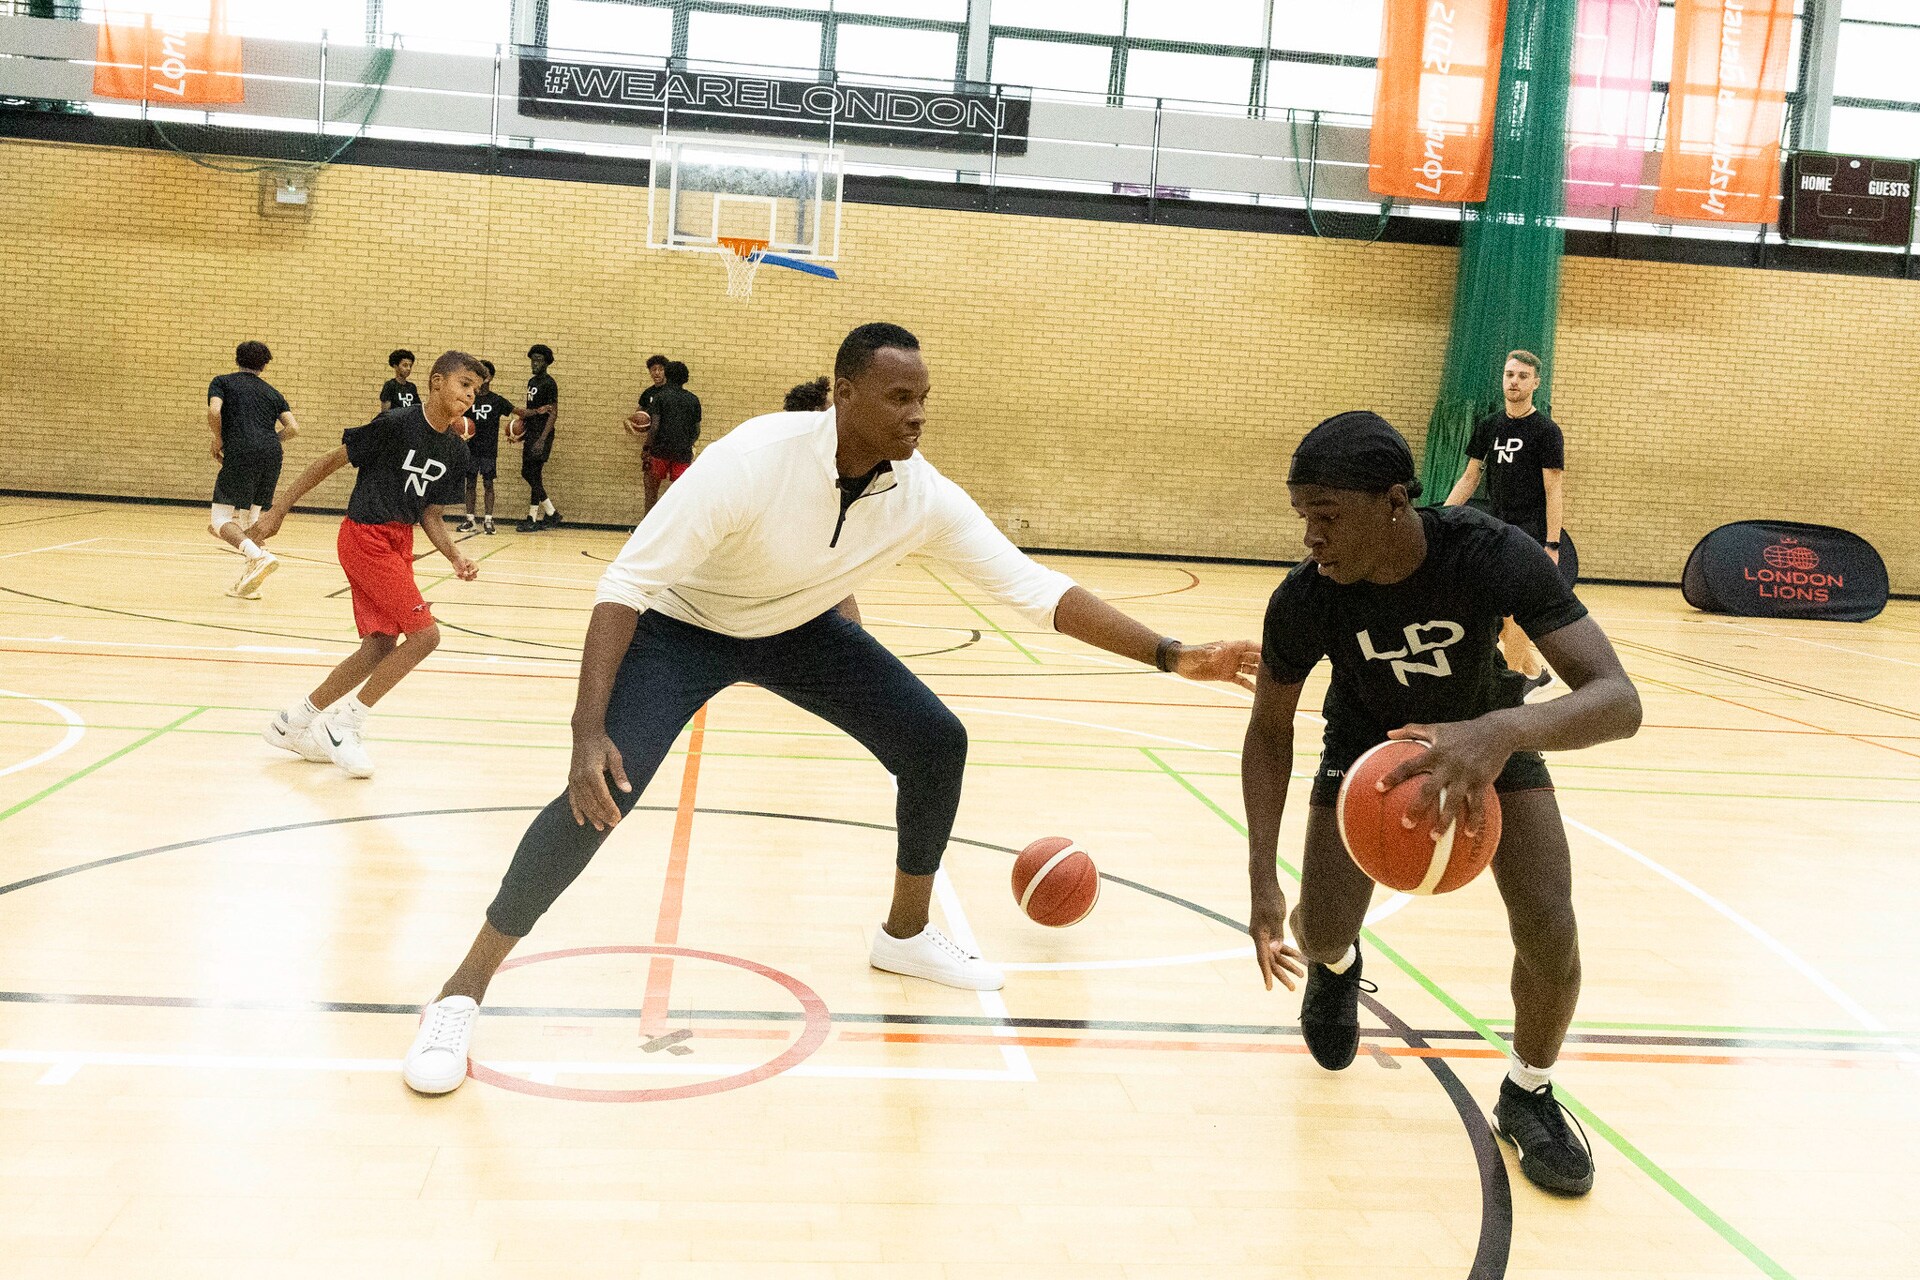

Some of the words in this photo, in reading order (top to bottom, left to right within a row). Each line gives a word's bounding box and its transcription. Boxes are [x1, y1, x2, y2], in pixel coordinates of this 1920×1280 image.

[1424, 1, 1455, 74] 2012
[153, 28, 186, 96] Lon
[544, 64, 1005, 130] #WEARELONDON
[1801, 175, 1832, 192] HOME
[1868, 180, 1910, 198] GUESTS
[1744, 567, 1843, 588] LONDON
[1759, 584, 1829, 602] LIONS
